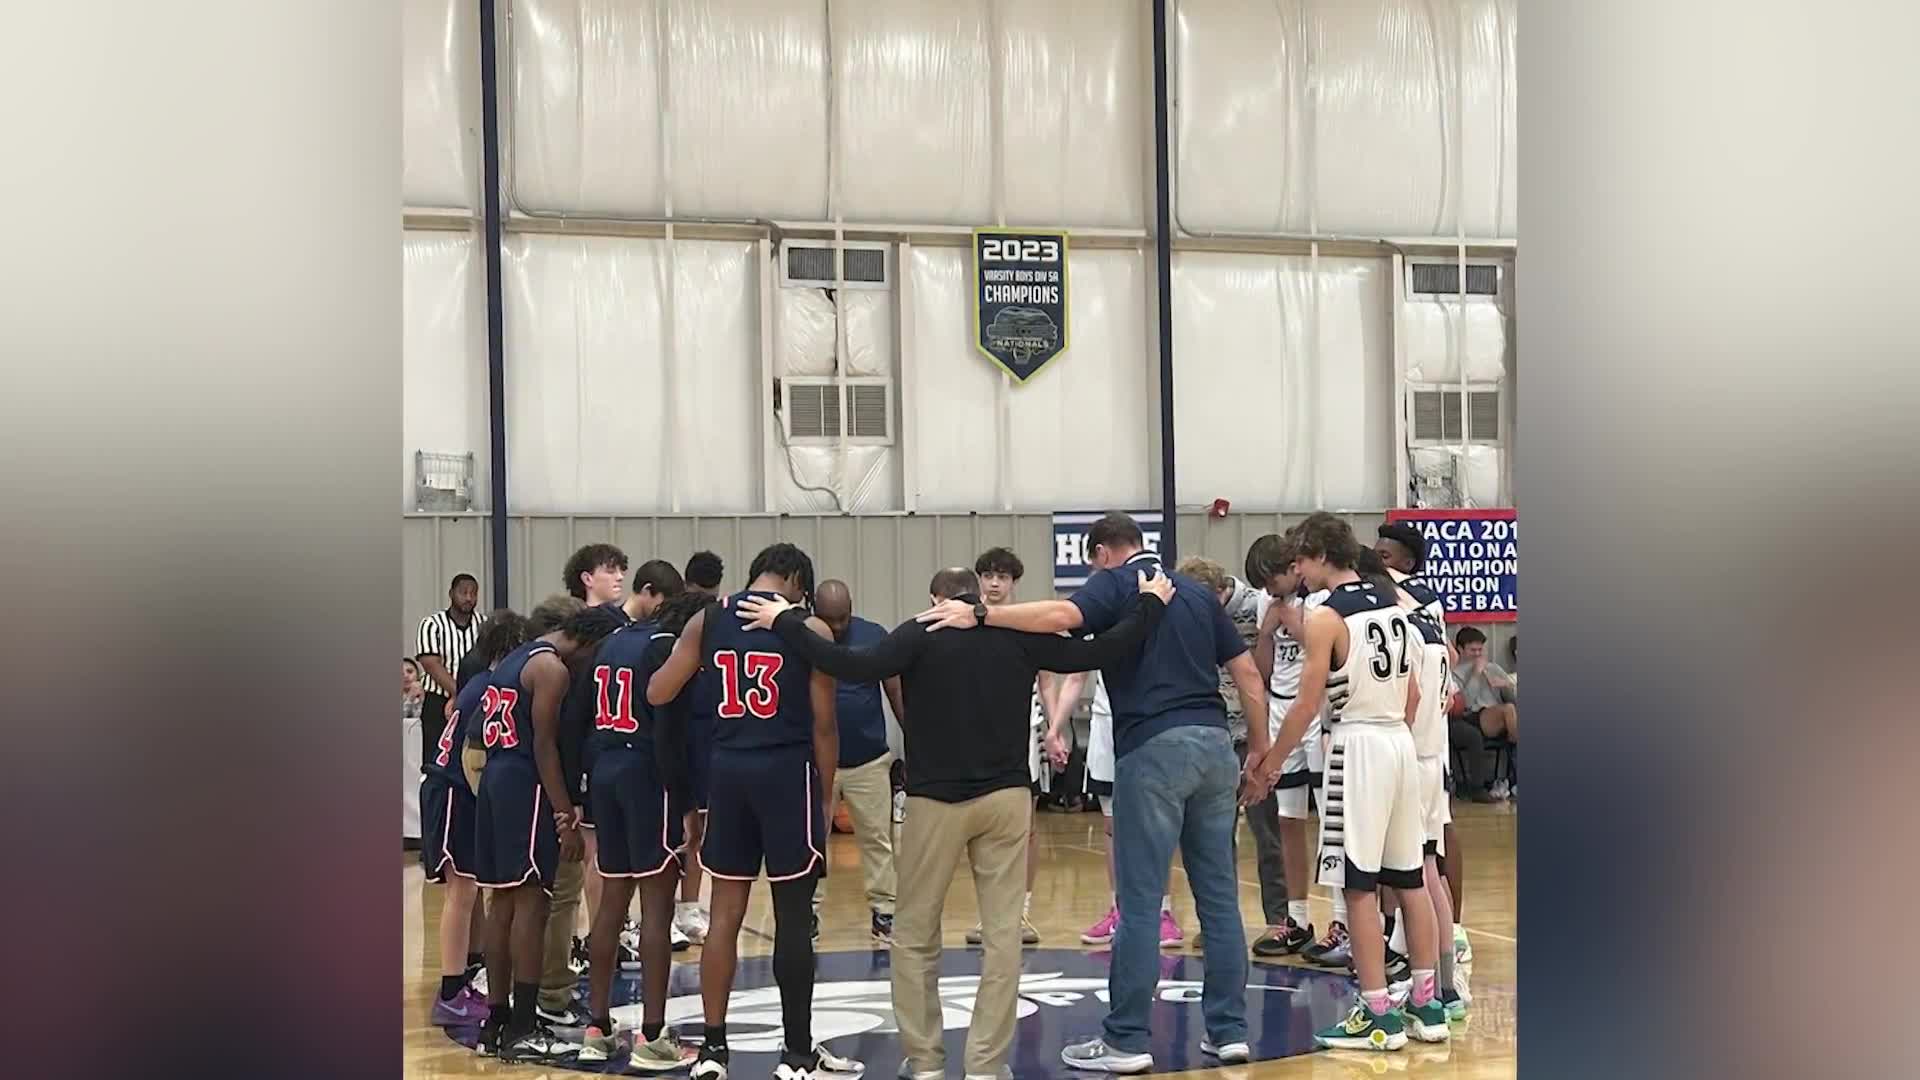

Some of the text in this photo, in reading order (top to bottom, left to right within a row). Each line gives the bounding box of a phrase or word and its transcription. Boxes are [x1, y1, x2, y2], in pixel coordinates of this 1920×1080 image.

[983, 240, 1058, 261] 2023
[983, 269, 1015, 282] VARSITY
[1015, 270, 1034, 282] BOYS
[984, 284, 1059, 304] CHAMPIONS
[1428, 541, 1517, 559] ATIONA
[1415, 559, 1517, 577] HAMPION
[1365, 613, 1410, 683] 32
[713, 650, 783, 719] 13
[594, 665, 639, 733] 11
[480, 685, 519, 748] 23
